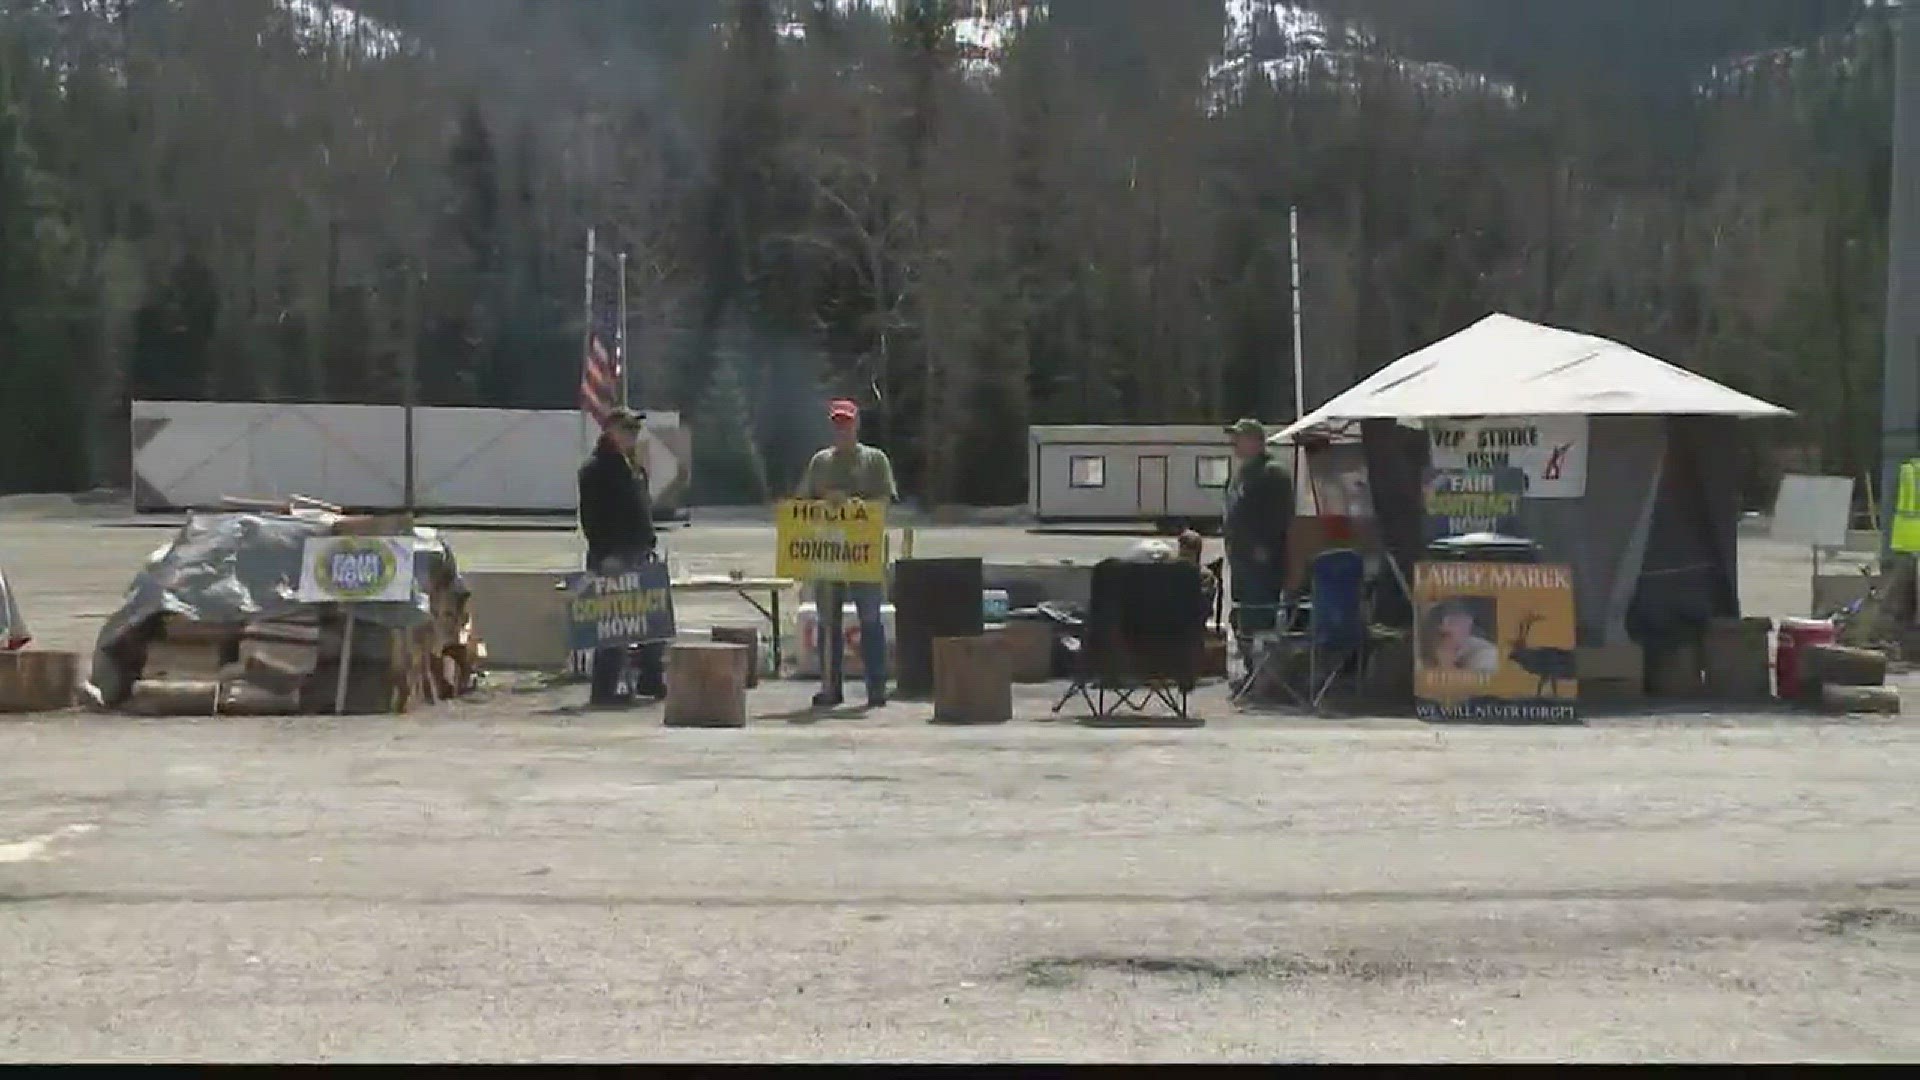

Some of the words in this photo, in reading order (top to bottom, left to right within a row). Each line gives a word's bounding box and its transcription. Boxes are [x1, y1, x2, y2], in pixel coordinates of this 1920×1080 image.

[1450, 474, 1494, 493] FAIR
[790, 540, 870, 563] CONTRACT
[595, 572, 639, 594] FAIR
[573, 589, 666, 622] CONTRACT
[598, 612, 646, 638] NOW!
